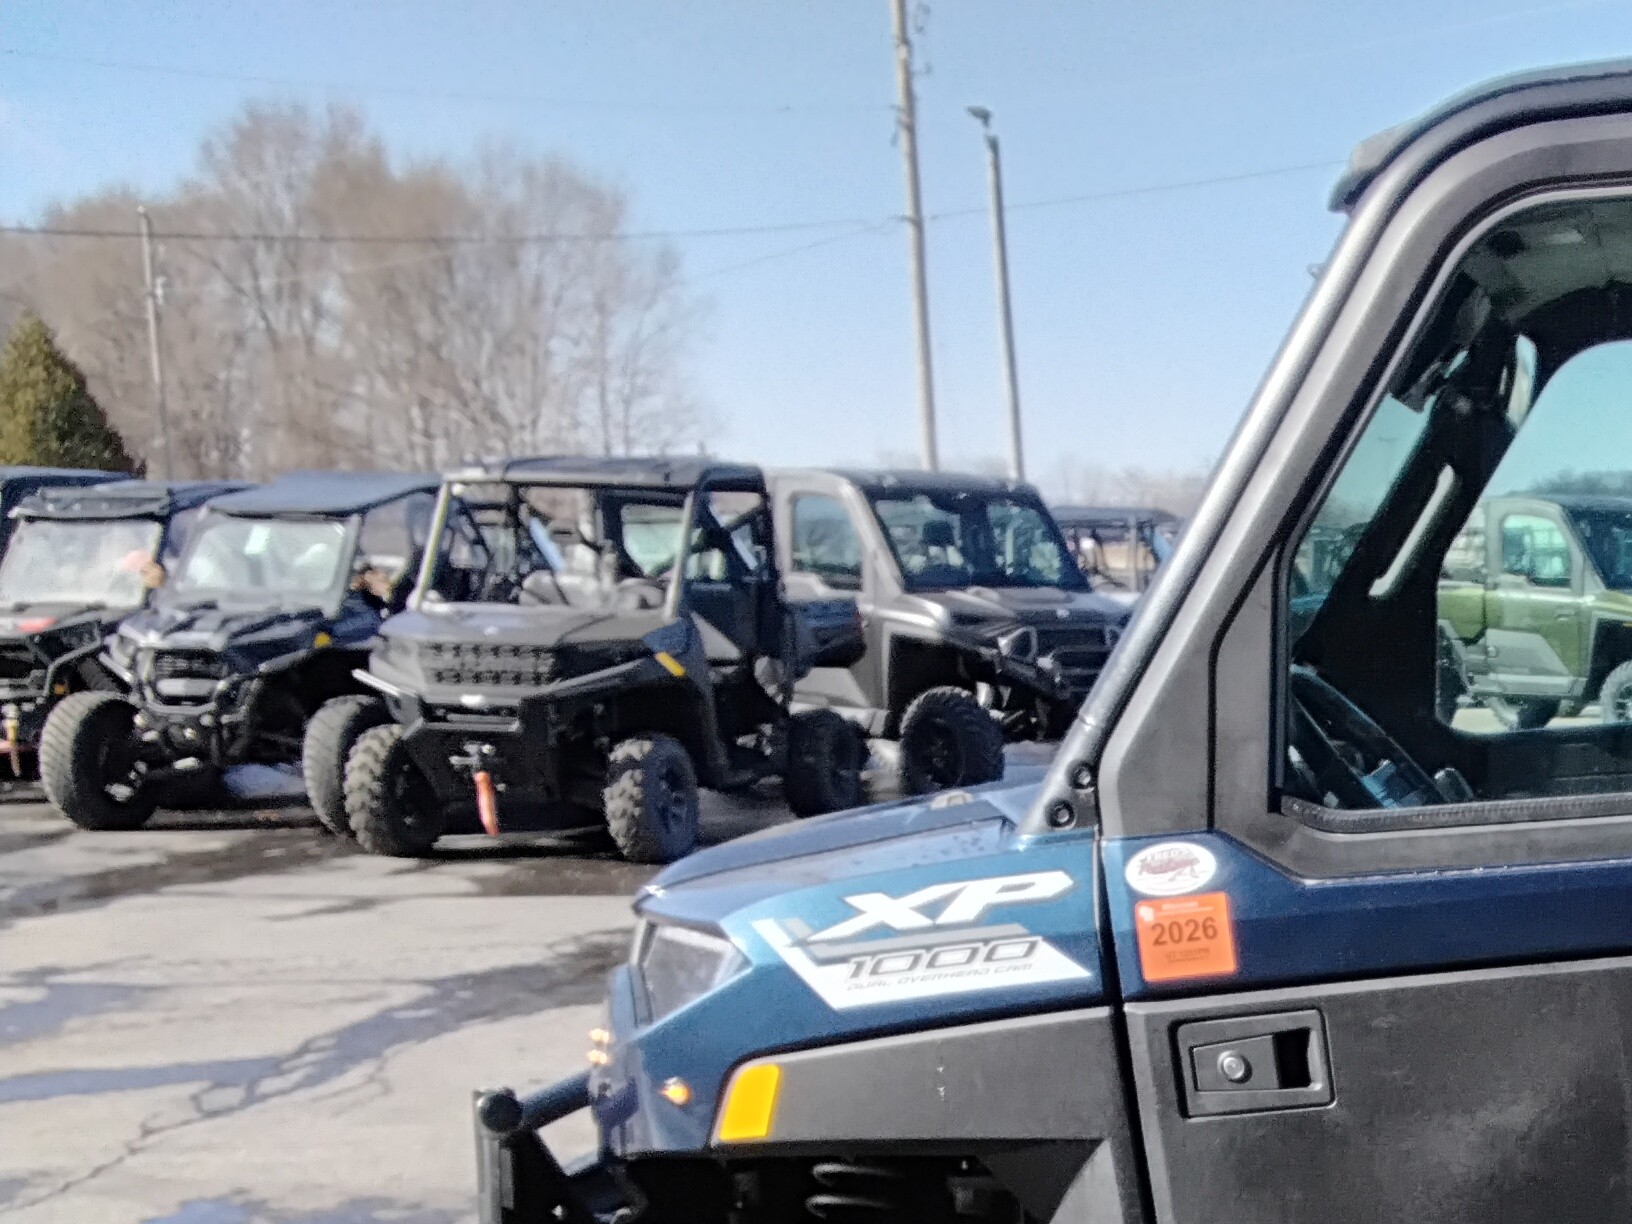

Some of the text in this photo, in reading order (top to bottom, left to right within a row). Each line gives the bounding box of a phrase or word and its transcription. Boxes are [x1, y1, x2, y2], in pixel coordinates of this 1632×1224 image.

[806, 869, 1074, 942] XP
[1151, 916, 1218, 947] 2026
[848, 937, 1041, 980] 1000
[898, 967, 990, 984] OVERHEAD
[995, 962, 1033, 975] CAM
